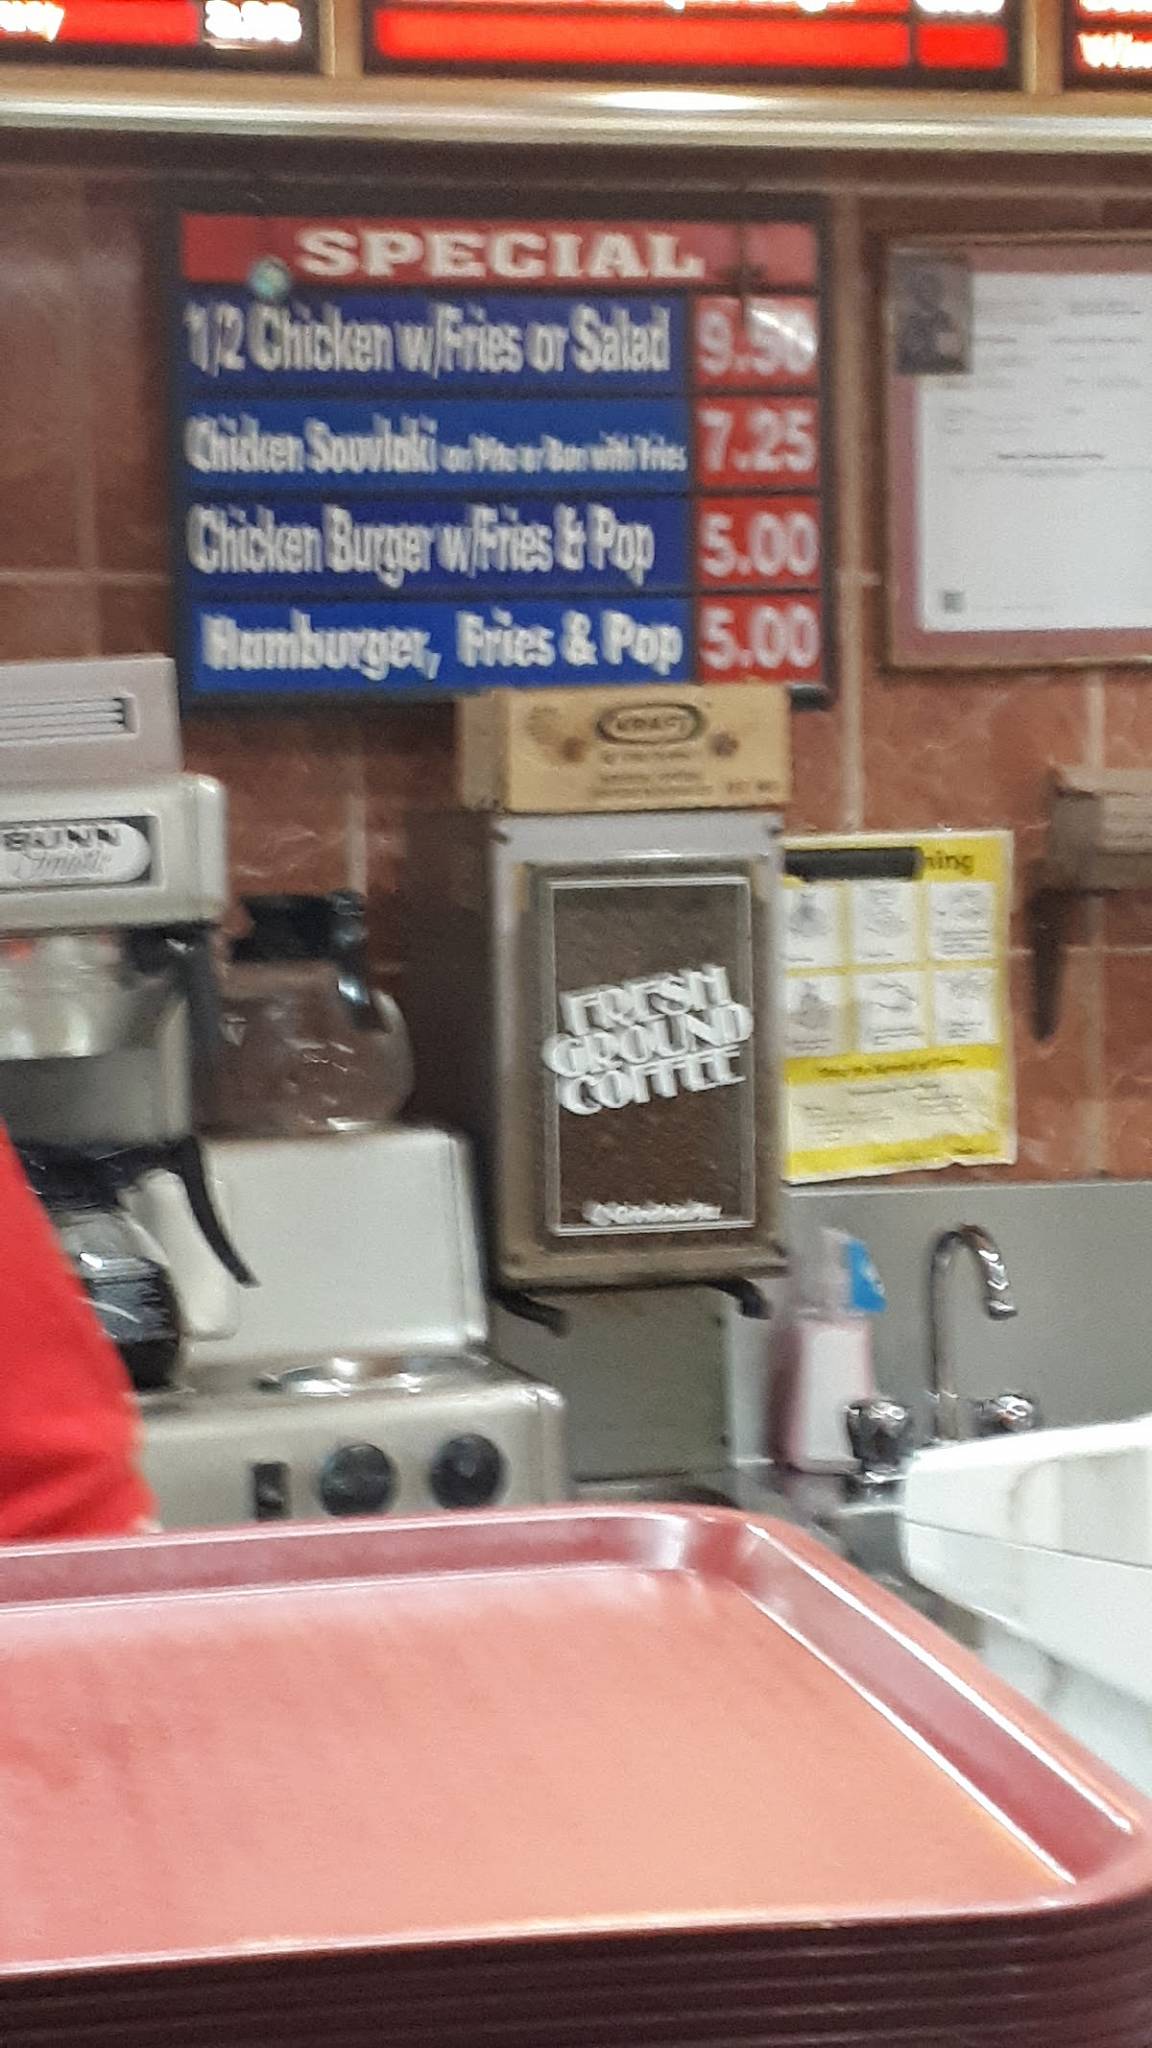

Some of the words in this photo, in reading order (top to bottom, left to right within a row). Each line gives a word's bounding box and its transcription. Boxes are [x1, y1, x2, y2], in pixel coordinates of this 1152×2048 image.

[298, 229, 704, 278] SPECIAL
[183, 301, 246, 377] 1/2
[251, 302, 394, 371] Chicken
[396, 302, 522, 379] w/Fries
[526, 321, 569, 372] or
[570, 303, 671, 372] Salad
[185, 412, 304, 473] Chicken
[304, 413, 438, 473] Souvlaki
[700, 409, 817, 473] 7.25
[187, 503, 323, 573] Chicken
[322, 503, 434, 588] Burger
[436, 503, 553, 578] w/Fries
[554, 503, 586, 571] &
[586, 502, 655, 587] Pop
[700, 512, 819, 577] 5.00
[202, 607, 442, 681] Hamburger,
[455, 606, 555, 668] Fries
[560, 609, 598, 667] &
[602, 609, 683, 676] Pop
[700, 605, 819, 670] 5.00
[2, 829, 121, 852] BUNN
[560, 962, 733, 1036] FRESH
[542, 1002, 754, 1079] GROUND
[558, 1044, 747, 1115] COFFEE
